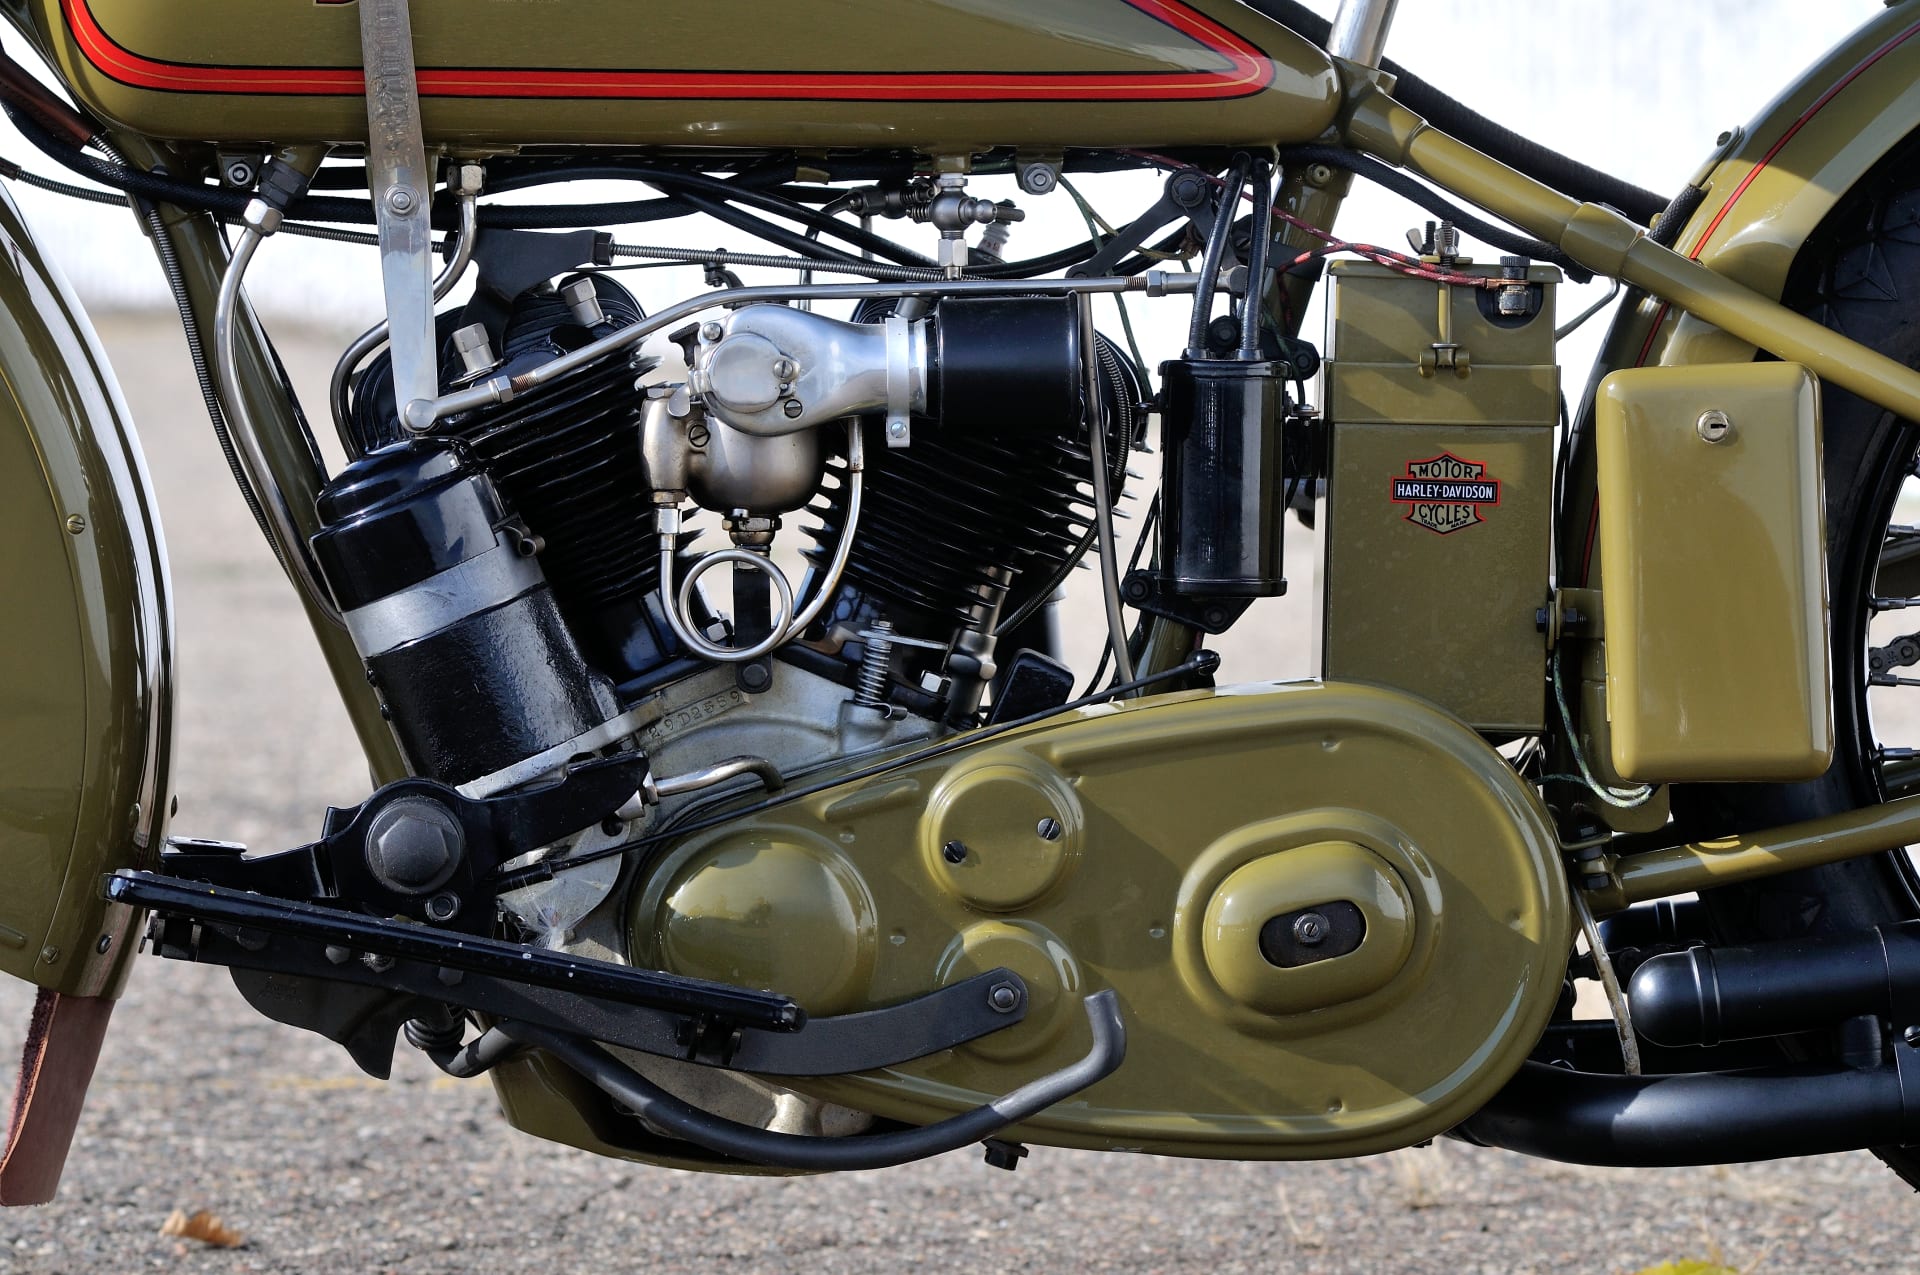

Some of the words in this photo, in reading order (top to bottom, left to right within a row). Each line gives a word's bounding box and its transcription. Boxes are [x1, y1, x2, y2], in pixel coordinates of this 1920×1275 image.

[1419, 458, 1473, 478] MOTOR
[1397, 484, 1493, 499] HARLEY-DAVIDSON
[1418, 504, 1471, 525] CYCLES
